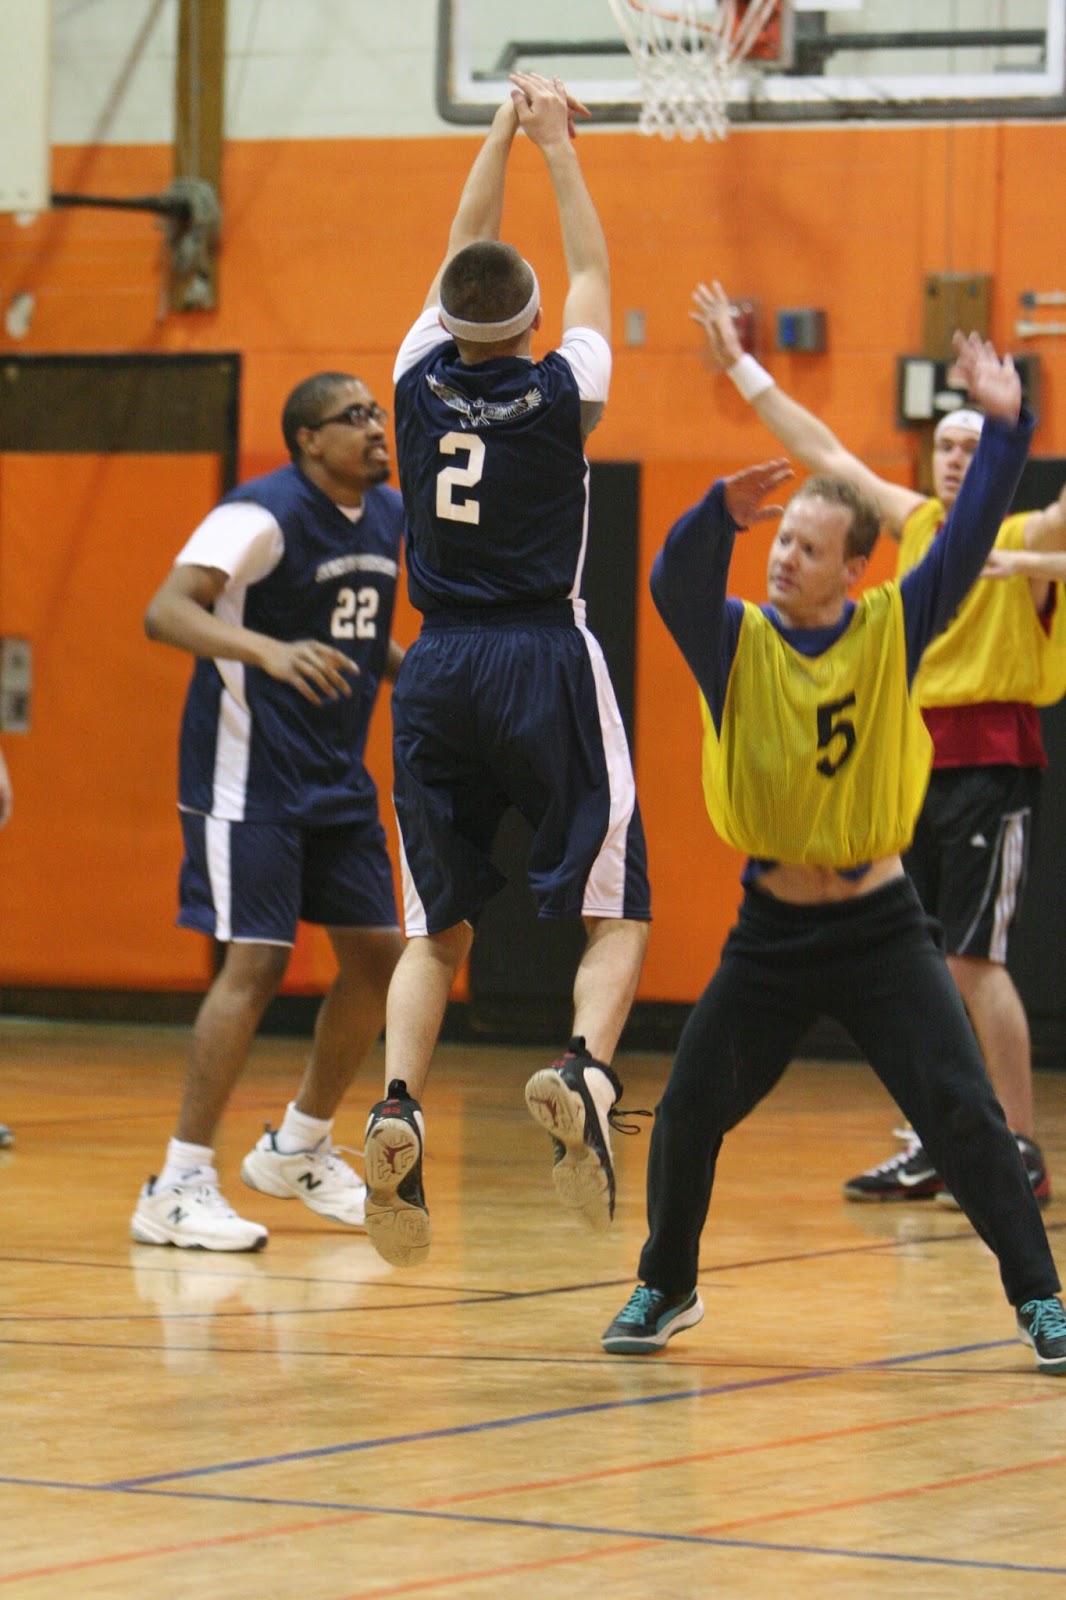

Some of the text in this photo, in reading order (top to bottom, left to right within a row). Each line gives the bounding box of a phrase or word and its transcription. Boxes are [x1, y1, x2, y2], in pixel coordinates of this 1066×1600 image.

[436, 431, 486, 525] 2
[331, 587, 379, 639] 22
[816, 690, 857, 778] 5
